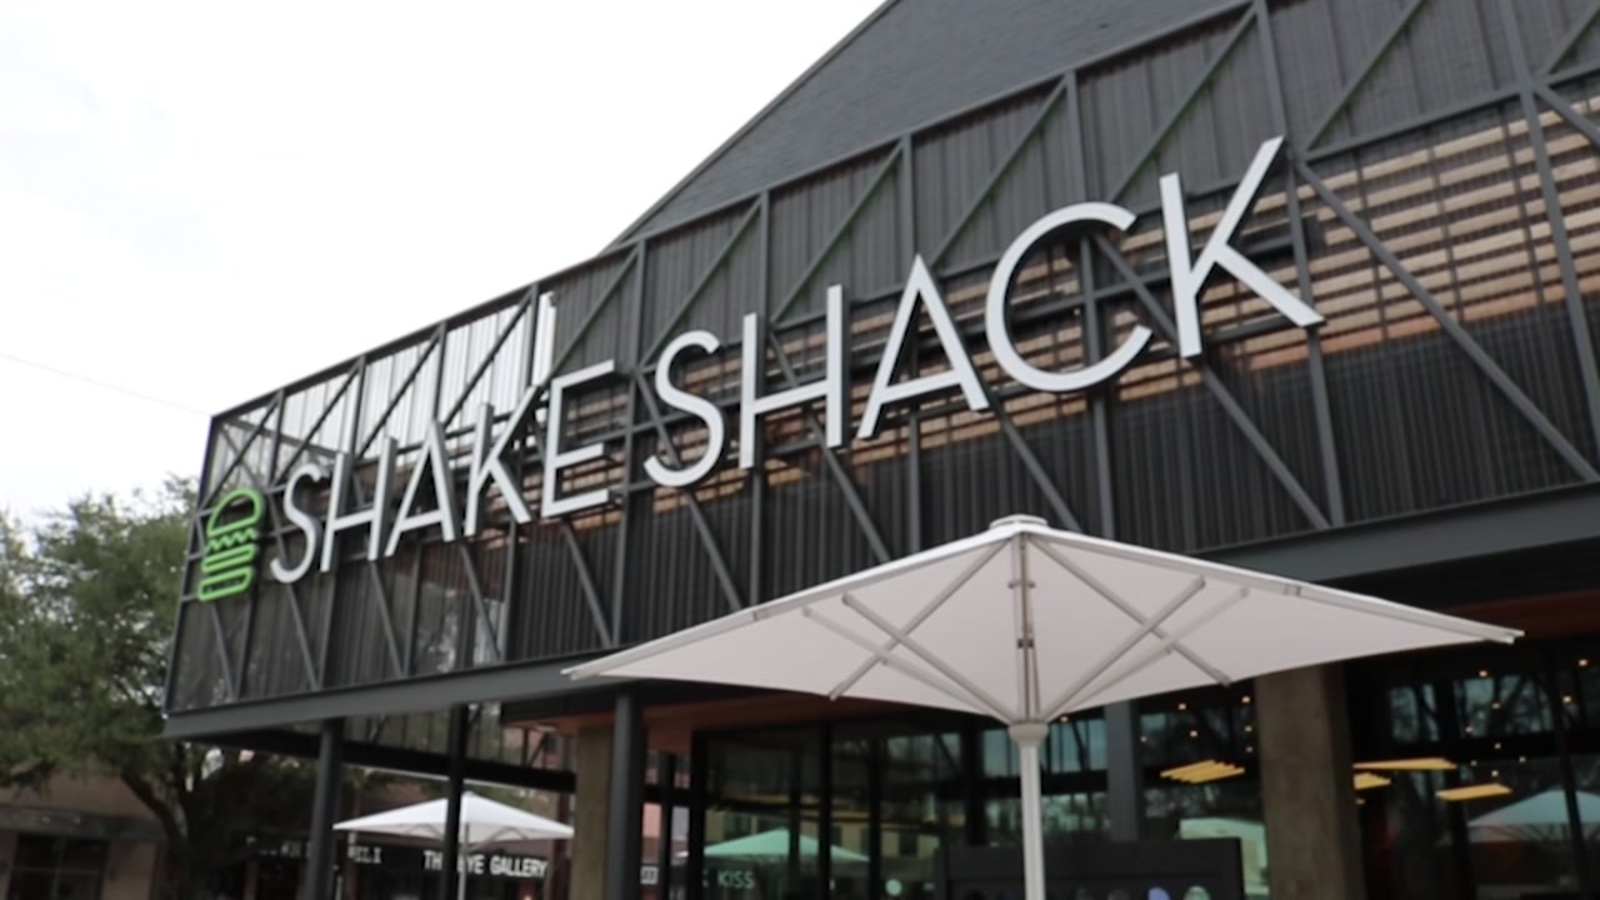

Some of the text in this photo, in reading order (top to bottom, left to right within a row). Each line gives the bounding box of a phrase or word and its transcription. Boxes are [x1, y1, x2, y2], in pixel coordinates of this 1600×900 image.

[270, 135, 1325, 584] SHAKE SHACK
[423, 850, 446, 870] TH
[490, 855, 548, 877] GALLERY
